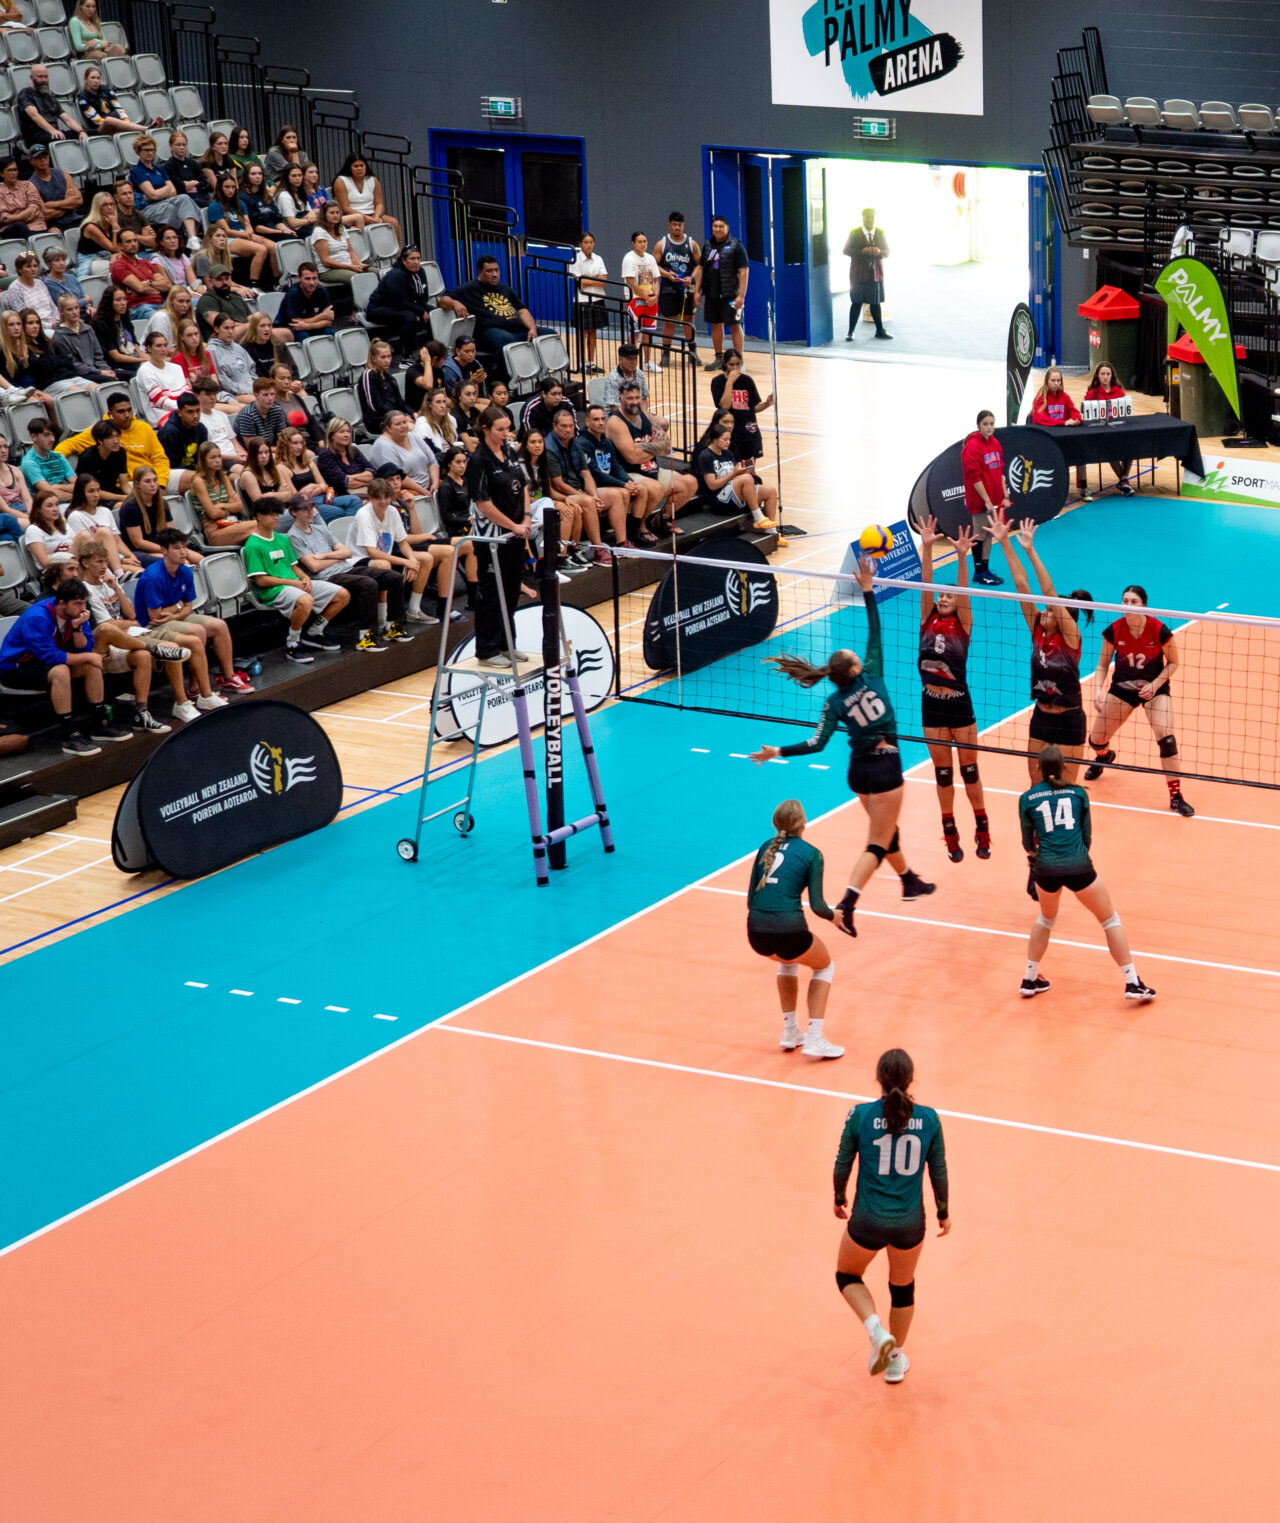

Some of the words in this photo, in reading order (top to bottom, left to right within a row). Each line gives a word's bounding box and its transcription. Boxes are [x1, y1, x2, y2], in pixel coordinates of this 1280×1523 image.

[824, 0, 911, 67] PALMY
[884, 40, 943, 91] ARENA
[1168, 268, 1227, 341] PALMY
[880, 543, 913, 564] UNIVERSITY
[691, 602, 703, 616] NEW
[703, 595, 725, 611] ZEALAND
[934, 634, 946, 654] 6
[1127, 652, 1146, 670] 12
[847, 690, 886, 727] 16
[925, 689, 947, 700] NIKE
[546, 665, 562, 789] VOLLEYBALL
[160, 792, 199, 818] VOLLEYBALL
[201, 781, 218, 800] NEW
[218, 772, 249, 793] ZEALAND
[192, 801, 223, 824] POIREWA
[223, 788, 258, 811] AOTEAROA
[1035, 797, 1076, 833] 14
[765, 852, 785, 884] 2
[873, 1133, 921, 1176] 10
